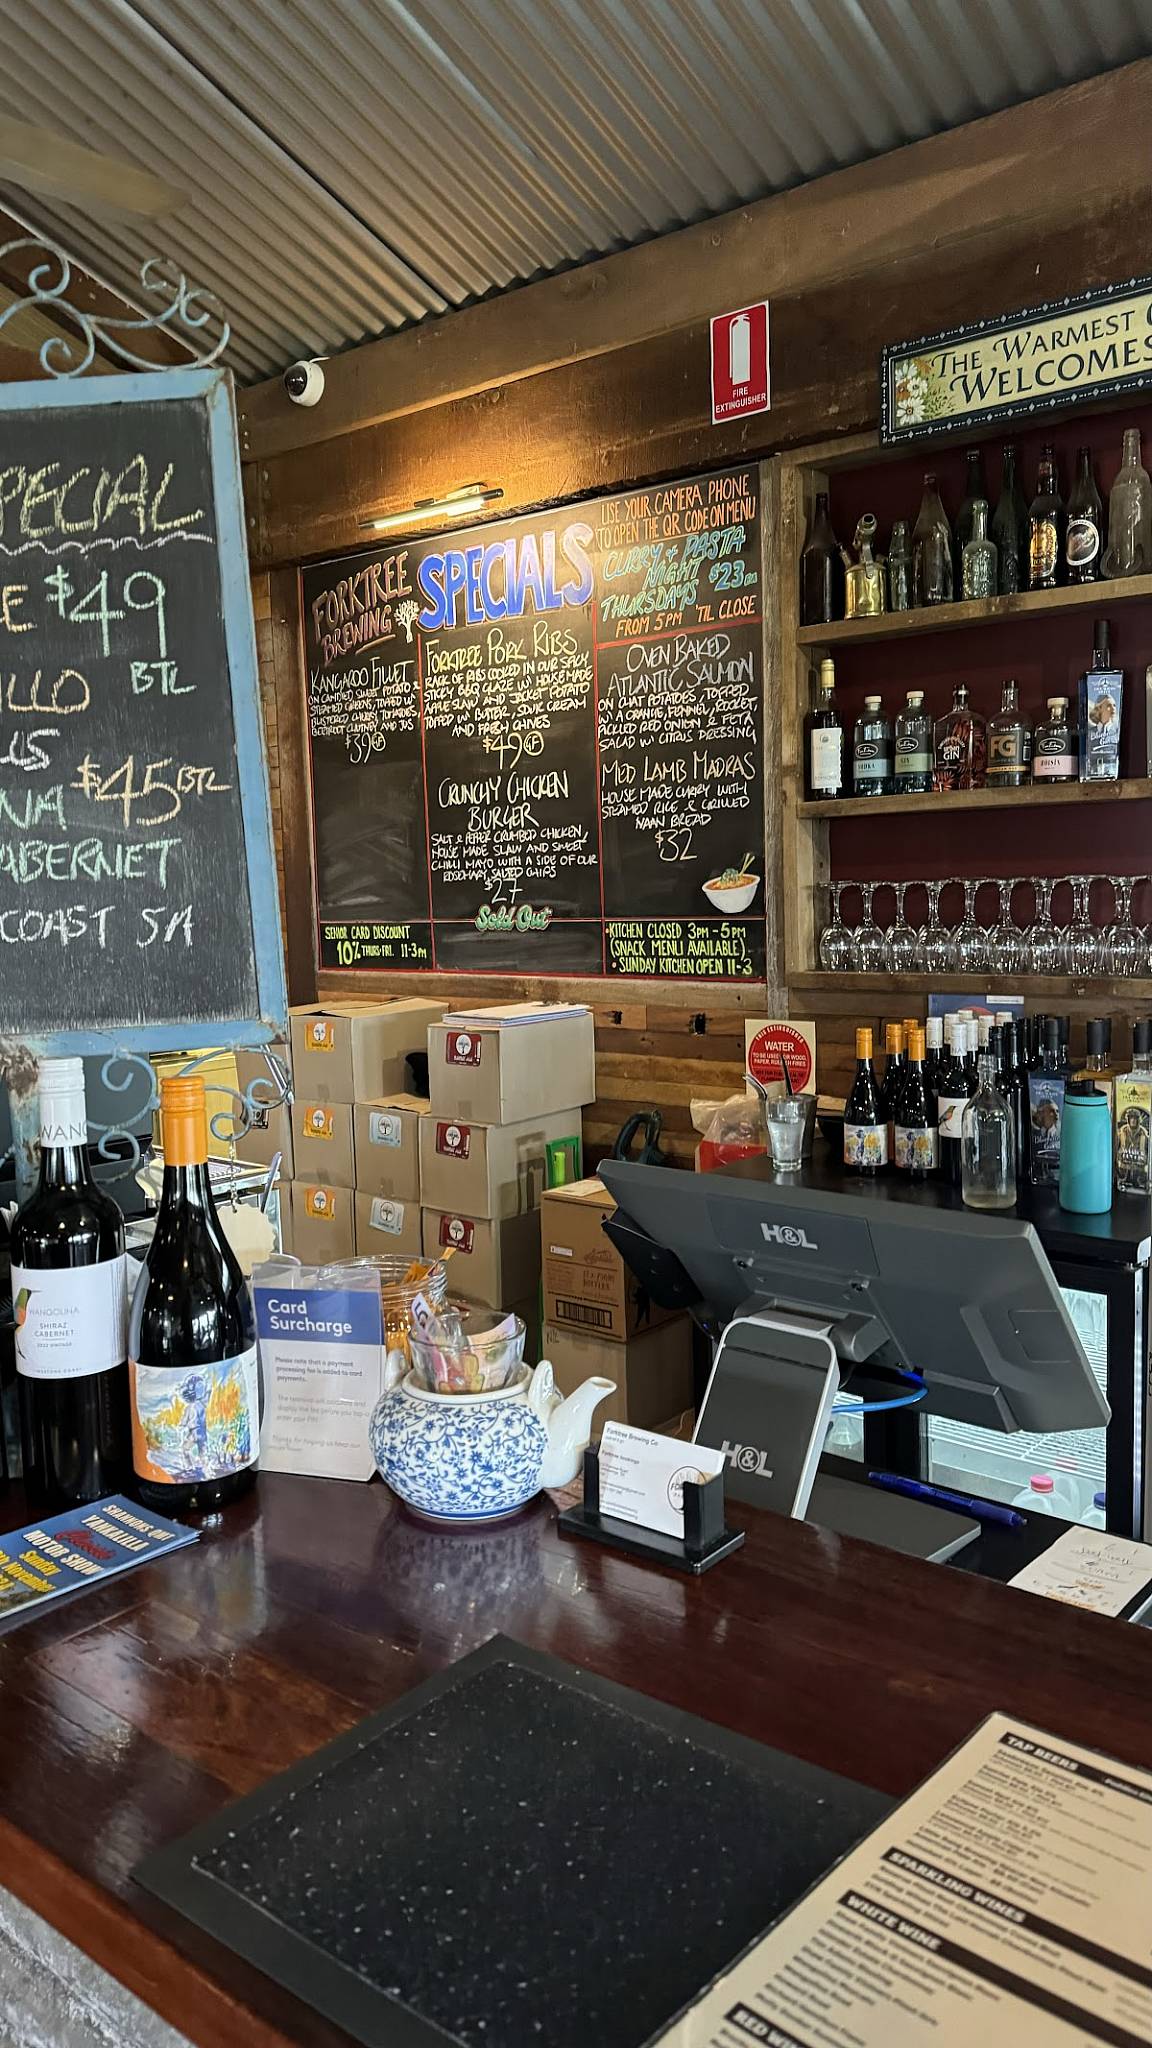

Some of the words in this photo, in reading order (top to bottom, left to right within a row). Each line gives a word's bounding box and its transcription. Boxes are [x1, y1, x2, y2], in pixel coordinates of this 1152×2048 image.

[931, 350, 982, 378] THE
[993, 310, 1135, 362] WARMEST
[716, 393, 766, 413] EXTINGUISHER
[732, 387, 749, 398] FIRE
[601, 501, 620, 525] USE
[625, 496, 651, 520] YOUR
[655, 485, 703, 515] CAMERA
[709, 474, 750, 503] PHONE
[614, 523, 639, 546] OPEN
[644, 516, 659, 539] THE
[663, 513, 681, 535] QR
[685, 508, 708, 533] CODE
[711, 506, 724, 523] ON
[727, 496, 756, 523] MENU
[603, 542, 664, 581] CURRY
[681, 525, 746, 565] PASTA
[416, 522, 596, 632] SPECIALS
[642, 557, 705, 590] NIGHT
[311, 550, 413, 642] FORKTREE
[601, 579, 699, 622] THURSDAYS
[709, 560, 745, 592] $23
[44, 564, 167, 658] $49
[616, 616, 650, 638] FROM
[719, 595, 757, 618] CLOSE
[320, 603, 393, 667] BREWING
[426, 640, 483, 676] FORKTREE
[487, 628, 527, 665] PORK
[533, 620, 578, 657] RIBS
[627, 644, 670, 672] OVEN
[673, 634, 730, 668] BAKED
[130, 661, 197, 694] BTL
[311, 665, 368, 695] KANGAROO
[370, 657, 415, 690] FILLET
[383, 682, 411, 696] POTATO
[425, 676, 450, 689] RACK
[452, 675, 463, 684] OF
[467, 669, 486, 683] RIBS
[488, 665, 520, 681] COOKED
[523, 660, 534, 676] IN
[538, 660, 558, 674] OUR
[458, 683, 480, 698] BBQ
[483, 680, 514, 695] GLAZE
[608, 667, 684, 697] ATLANTIC
[687, 652, 754, 689] SALMON
[483, 695, 505, 706] AND
[550, 682, 589, 700] POTATO
[598, 700, 613, 711] ON
[704, 683, 750, 700] TOPPED
[425, 714, 454, 729] TOPPED
[517, 702, 544, 716] SOUR
[547, 696, 586, 712] CREAM
[452, 724, 474, 737] AND
[478, 721, 509, 735] FRESH
[513, 715, 550, 731] CHIVES
[598, 723, 637, 738] PICKLED
[640, 721, 661, 731] RED
[665, 719, 700, 731] ONION
[722, 711, 754, 725] FETA
[616, 711, 623, 722] A
[345, 732, 371, 763] $39
[483, 732, 522, 769] $49
[599, 735, 635, 752] SALAD
[699, 727, 757, 745] DRESSING
[644, 756, 687, 783] LAMB
[693, 750, 755, 780] MADRAS
[70, 754, 182, 830] $45
[176, 764, 233, 796] BTL
[439, 776, 501, 808] CRUNCHY
[507, 770, 568, 803] CHICKEN
[602, 789, 637, 806] HOUSE
[640, 784, 673, 801] MADE
[676, 784, 710, 798] CURRY
[718, 781, 747, 796] WITH
[468, 802, 539, 832] BURGER
[602, 802, 648, 819] STEAMED
[654, 800, 678, 815] RICE
[702, 796, 750, 810] GRILLED
[635, 816, 665, 830] NAAN
[671, 813, 712, 828] BREAD
[431, 834, 453, 846] SALT
[432, 846, 458, 859] HOUSE
[463, 845, 488, 858] MADE
[494, 845, 522, 855] SLAW
[526, 843, 548, 854] AND
[552, 840, 587, 851] SWEET
[654, 827, 698, 862] $32
[466, 858, 493, 869] MAYO
[498, 856, 521, 866] WITH
[526, 856, 534, 866] A
[536, 854, 556, 866] SIDE
[560, 855, 575, 865] OF
[577, 855, 597, 865] OUR
[491, 867, 523, 879] SALTED
[526, 866, 556, 878] CHIPS
[484, 877, 523, 904] $27
[0, 904, 116, 949] COAST
[136, 904, 195, 948] SA
[325, 926, 348, 939] SENIOR
[351, 926, 370, 939] CARD
[373, 926, 410, 939] DISCOUNT
[475, 905, 514, 932] Sold
[516, 905, 553, 931] Out
[609, 923, 643, 938] KITCHEN
[647, 923, 682, 938] CLOSED
[337, 941, 361, 965] 10%
[651, 940, 683, 956] MENU
[619, 957, 656, 973] SUNDAY
[659, 959, 694, 974] KITCHEN
[695, 959, 723, 974] OPEN
[765, 1041, 794, 1051] WATER
[761, 1222, 818, 1250] H&L
[267, 1299, 307, 1315] Card
[269, 1315, 353, 1337] Surcharge
[722, 1440, 774, 1479] H&L
[23, 1530, 71, 1558] MOTOR
[60, 1553, 105, 1575] SHOW
[1006, 1734, 1035, 1756] TAP
[1033, 1745, 1080, 1772] BEERS
[887, 1850, 976, 1899] SPARKLING
[971, 1890, 1027, 1925] WINES
[845, 1893, 902, 1928] WHITE
[898, 1920, 942, 1952] WINE
[734, 2010, 768, 2037] RED
